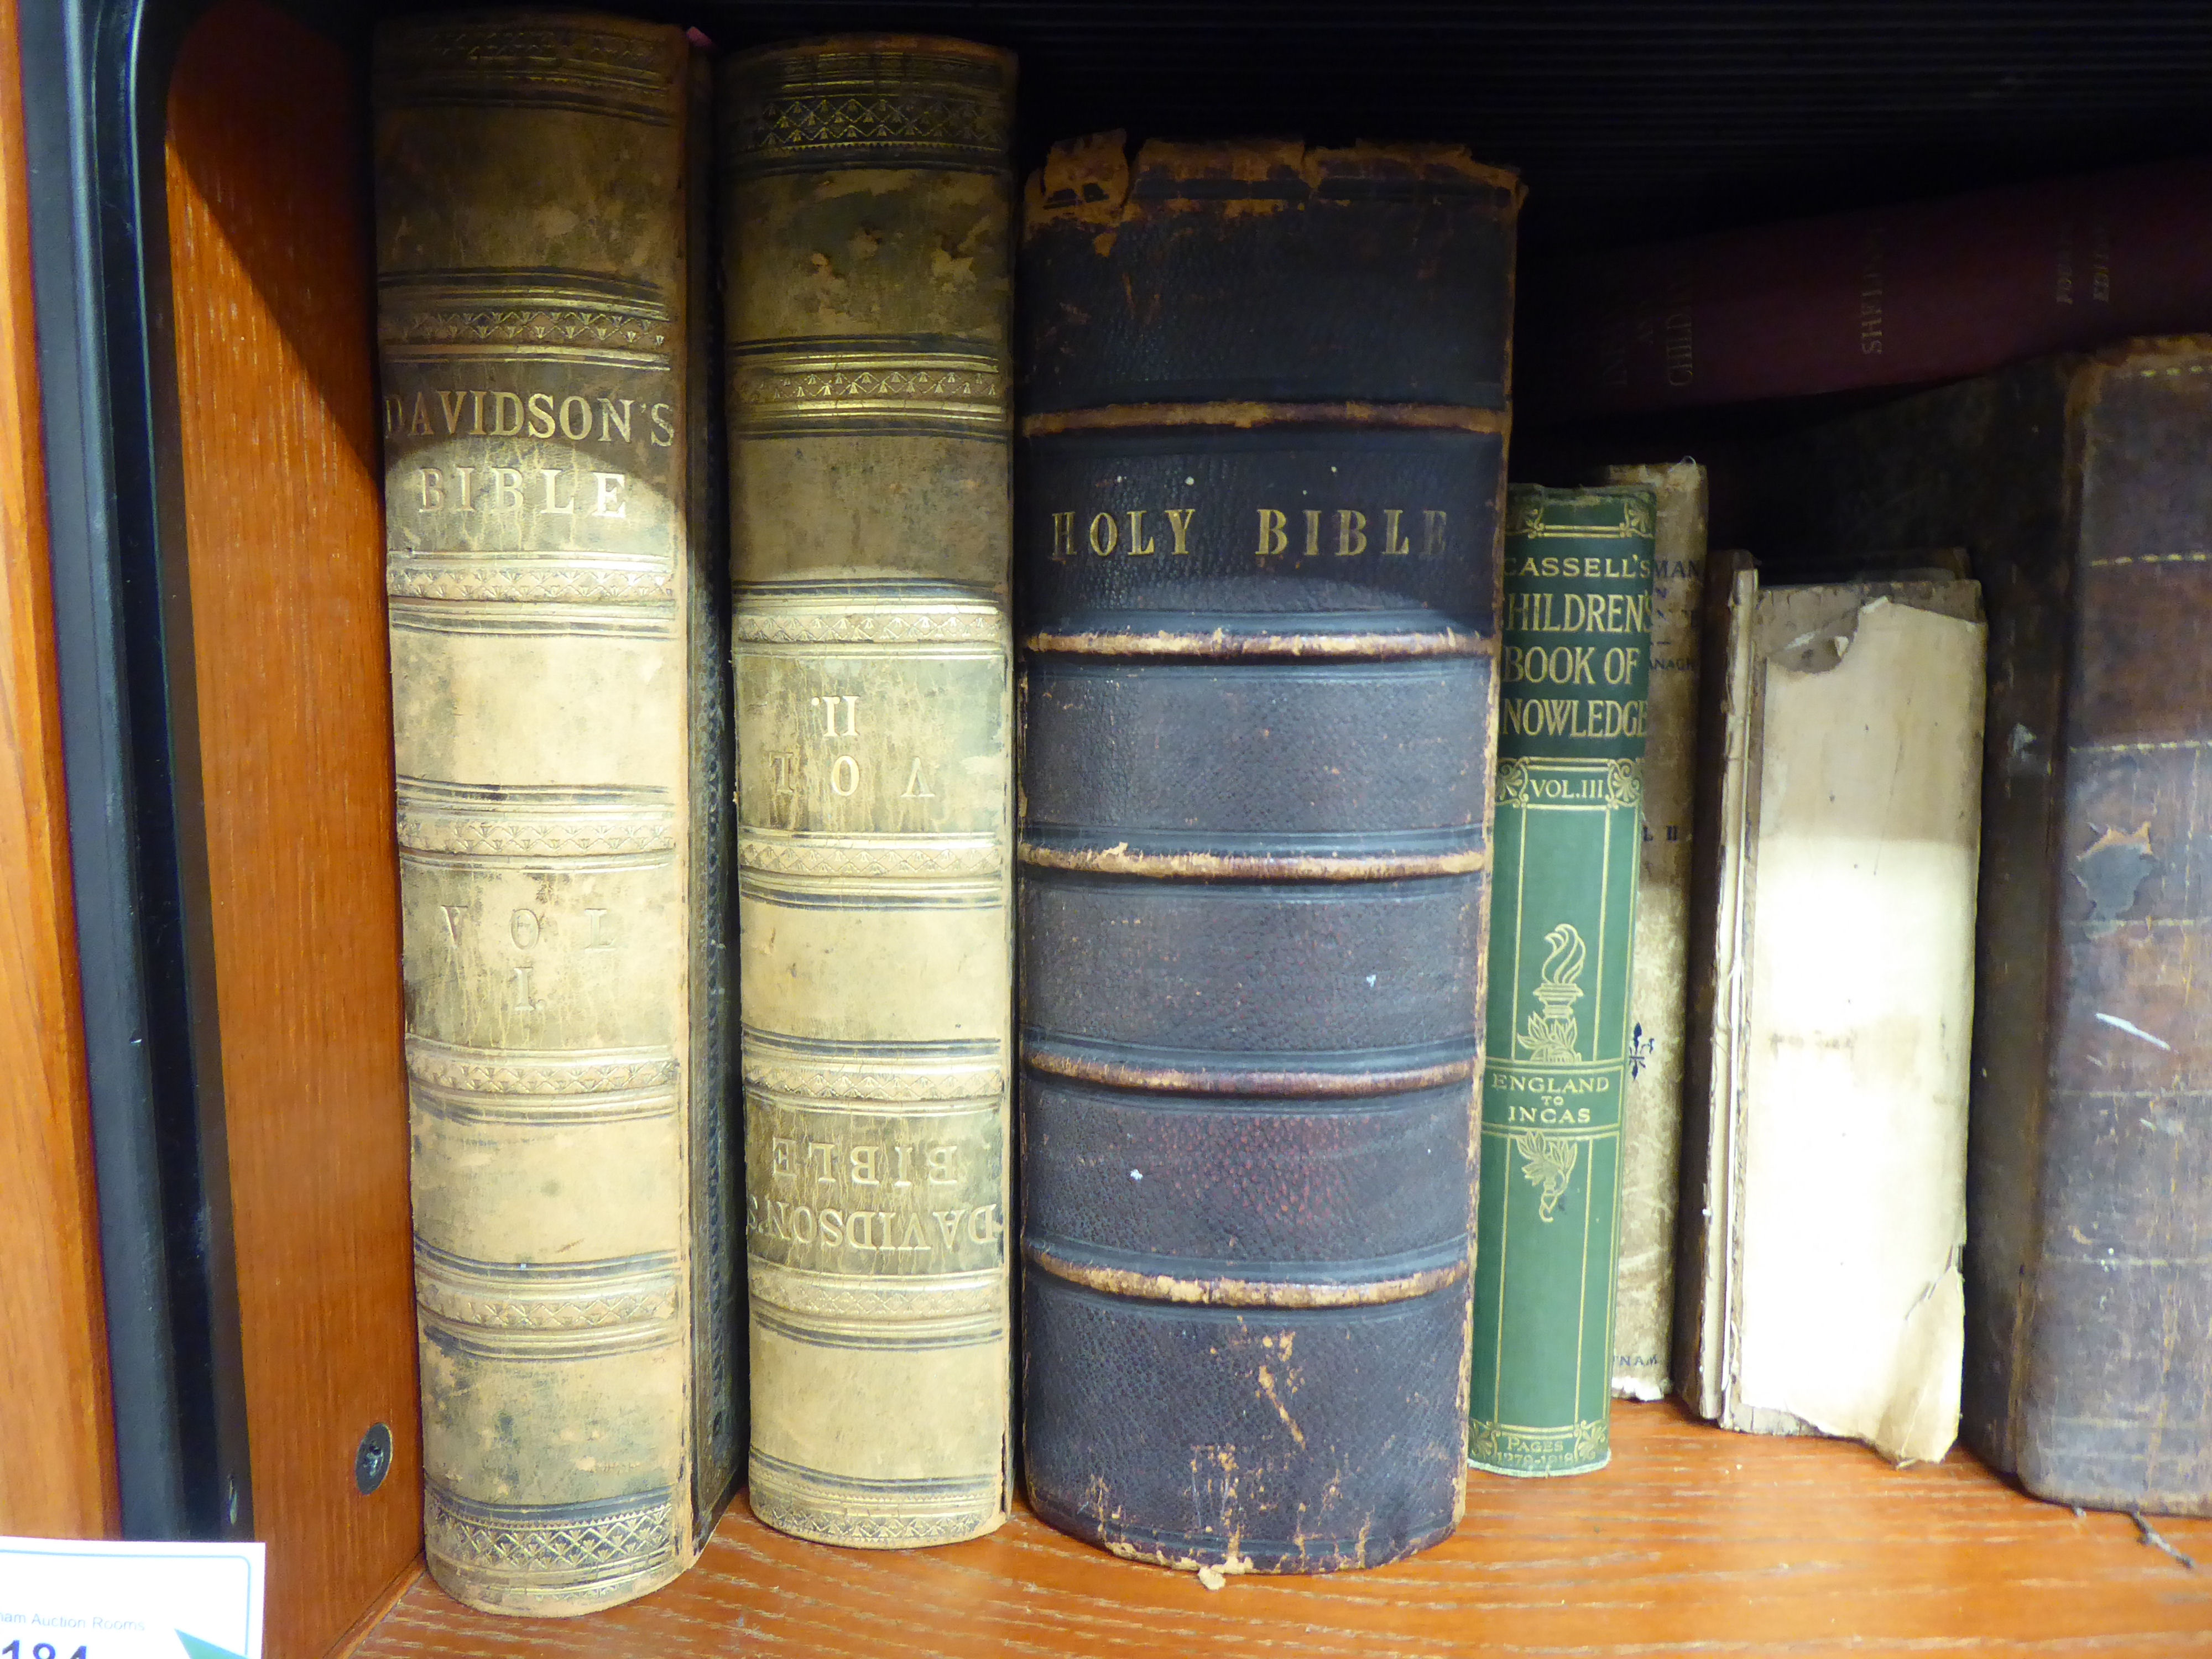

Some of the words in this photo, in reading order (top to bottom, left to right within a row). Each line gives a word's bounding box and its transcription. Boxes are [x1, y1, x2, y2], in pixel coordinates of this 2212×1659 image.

[387, 390, 675, 447] DAVIDSON'S
[419, 467, 626, 518] BIBLE
[1052, 508, 1195, 557] HOLY
[1255, 508, 1447, 560] BIBLE
[1505, 589, 1652, 634] HILDREN'S
[1503, 646, 1596, 685] BOOK
[1604, 647, 1640, 685] OF
[1499, 698, 1647, 738] NOWLEDGE
[769, 752, 935, 797] VOL
[441, 905, 617, 953] VOL
[1493, 1074, 1609, 1094] ENGLAND
[1541, 1095, 1564, 1107] TO
[1508, 1105, 1591, 1124] INCAS
[772, 1136, 958, 1187] BIBLE
[747, 1193, 997, 1251] DAVIDSON'S
[32, 1613, 86, 1629] Auction
[93, 1616, 145, 1631] Rooms
